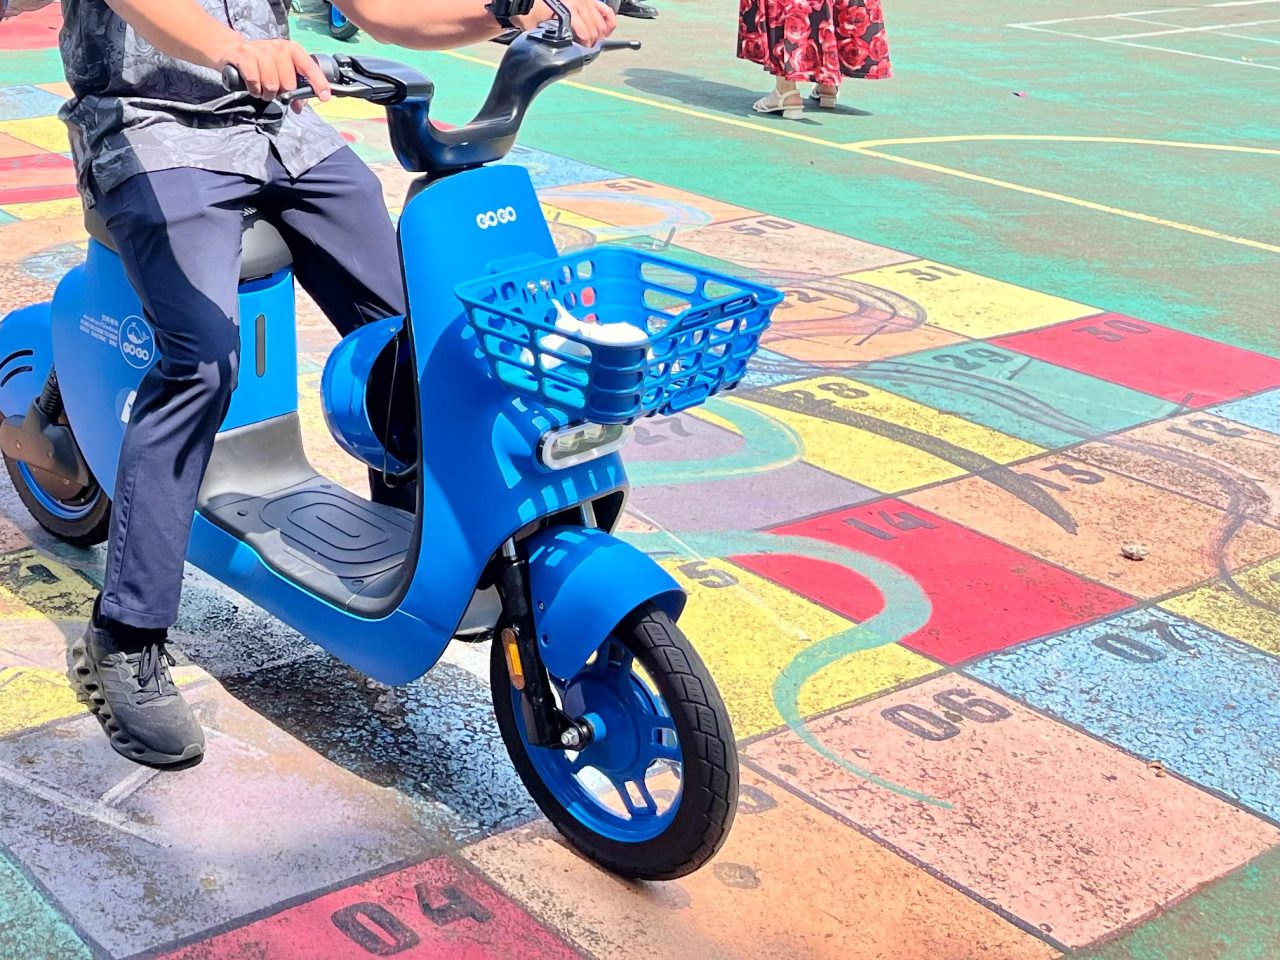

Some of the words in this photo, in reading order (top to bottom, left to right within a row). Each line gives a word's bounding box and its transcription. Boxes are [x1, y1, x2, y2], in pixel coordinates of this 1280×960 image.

[604, 180, 655, 192] 51
[476, 206, 517, 229] GOGO
[730, 219, 796, 237] 50
[895, 265, 961, 282] 31
[1073, 319, 1152, 343] 30
[123, 341, 150, 361] GOGO
[932, 346, 1014, 371] 29
[1165, 418, 1250, 446] 12
[841, 510, 940, 541] 14
[1092, 619, 1197, 665] 07
[880, 688, 1013, 741] 06
[331, 882, 495, 956] 04
